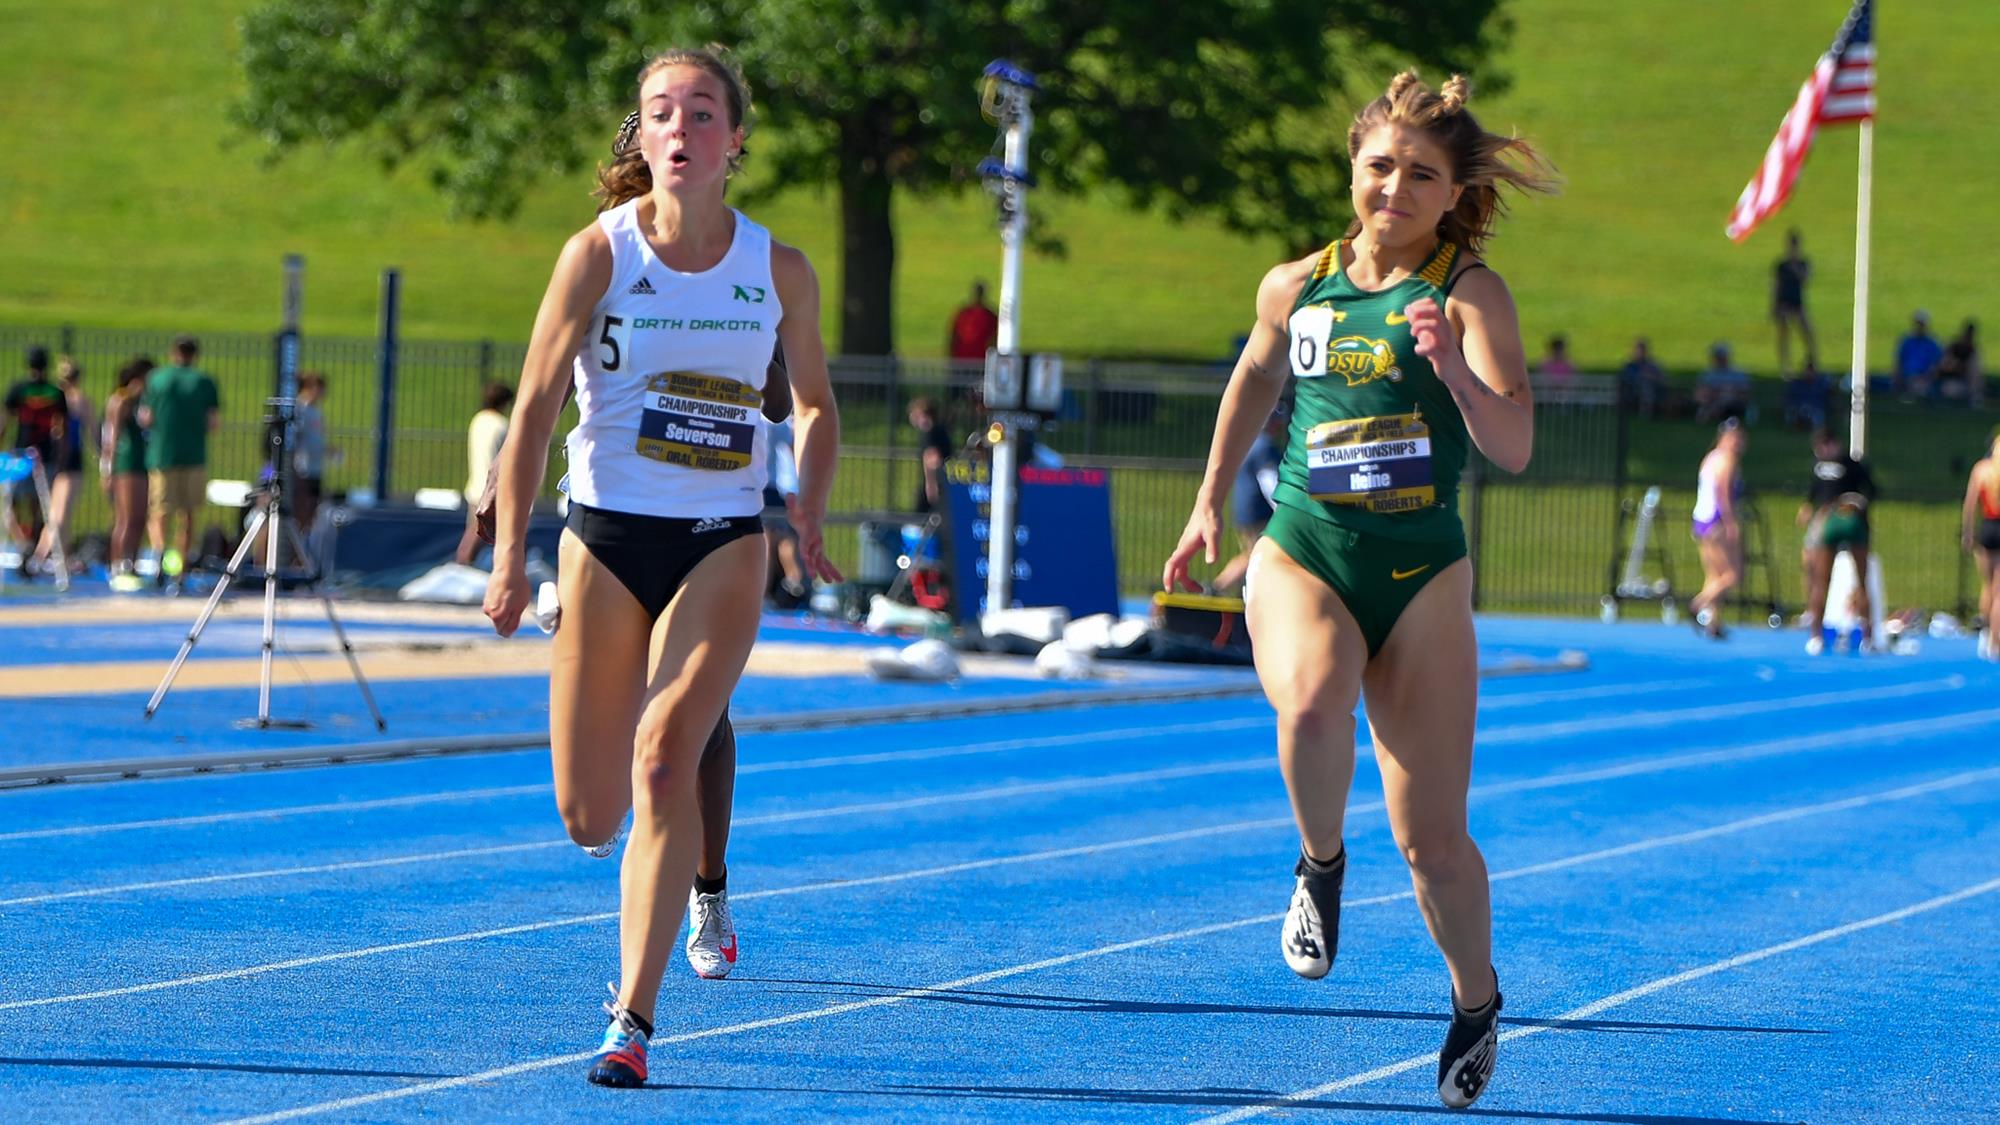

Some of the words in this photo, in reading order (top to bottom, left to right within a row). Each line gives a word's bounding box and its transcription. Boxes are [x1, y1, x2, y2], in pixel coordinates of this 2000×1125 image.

[629, 286, 657, 295] adidas
[632, 318, 682, 331] ORTH
[689, 319, 761, 332] DAKOTA
[600, 314, 623, 372] 5
[1327, 351, 1371, 374] DSU
[657, 395, 748, 422] CHAMPIONSHIPS
[665, 422, 731, 448] Severson
[1367, 418, 1402, 432] LEAGUE
[667, 451, 691, 466] ORAL
[696, 456, 741, 471] ROBERTS
[1321, 441, 1417, 464] CHAMPIONSHIPS
[1349, 472, 1391, 492] Heine
[1374, 495, 1422, 512] ROBERTS
[691, 520, 731, 533] adidas
